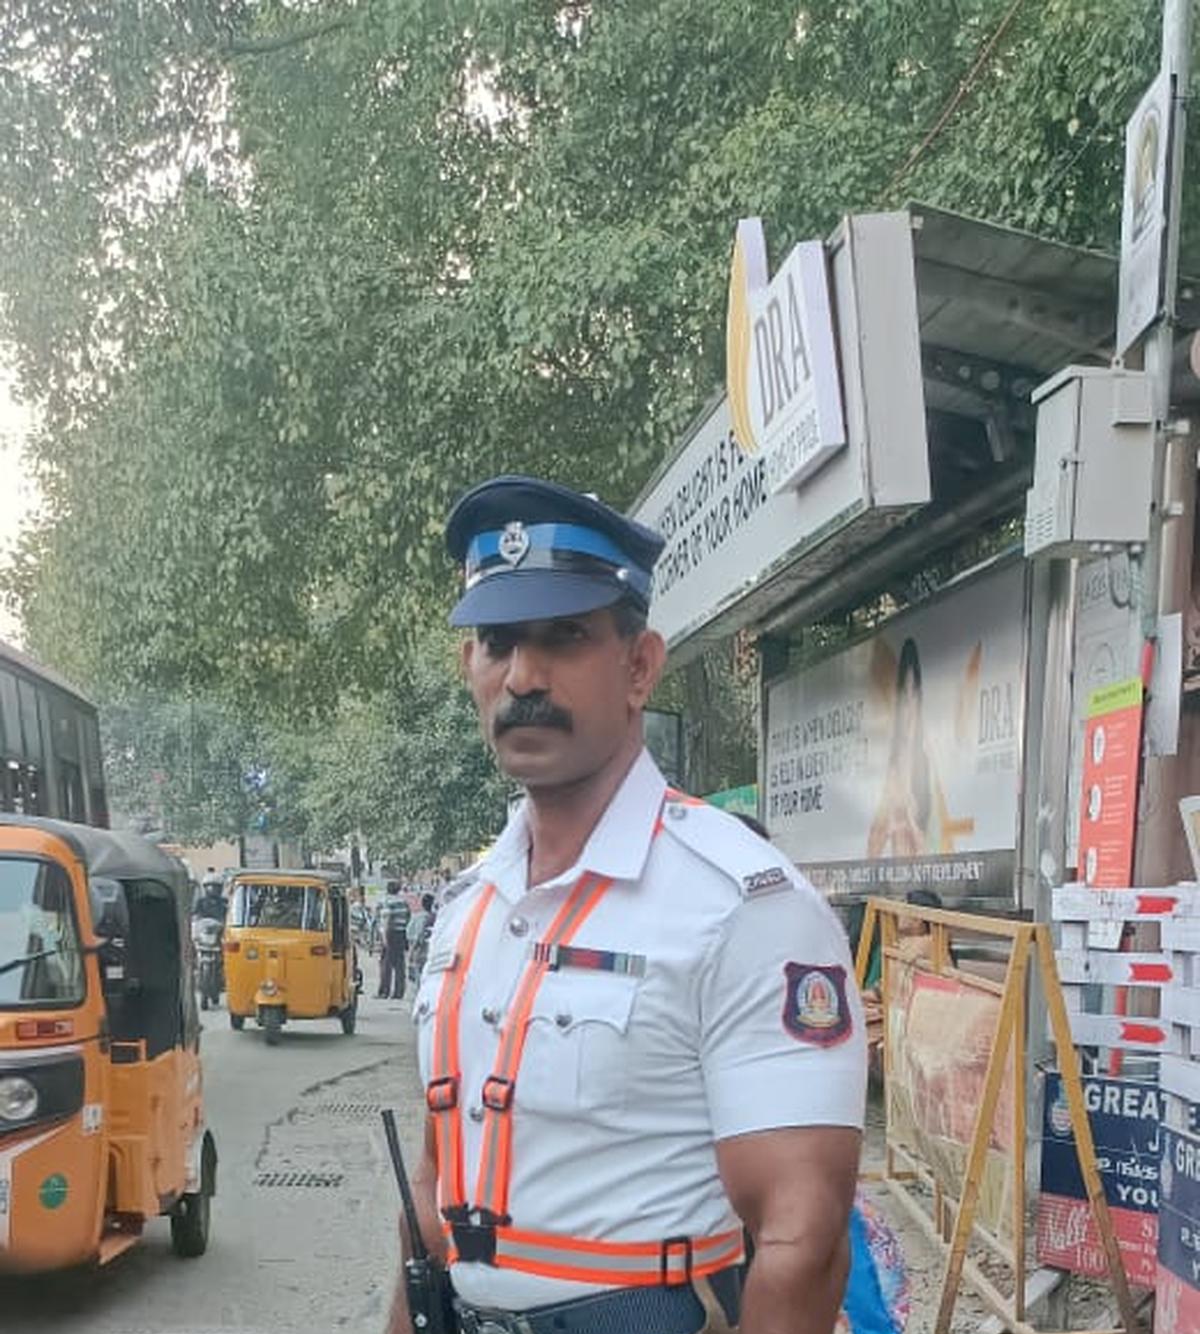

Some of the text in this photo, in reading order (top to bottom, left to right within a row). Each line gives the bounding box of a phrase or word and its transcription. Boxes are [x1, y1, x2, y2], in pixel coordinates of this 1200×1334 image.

[755, 273, 811, 428] DRA
[677, 456, 714, 527] DELIGHT
[715, 440, 728, 487] IS
[690, 523, 703, 567] OF
[703, 495, 733, 554] YOUR
[733, 457, 768, 528] HOME
[978, 682, 1014, 745] DRA
